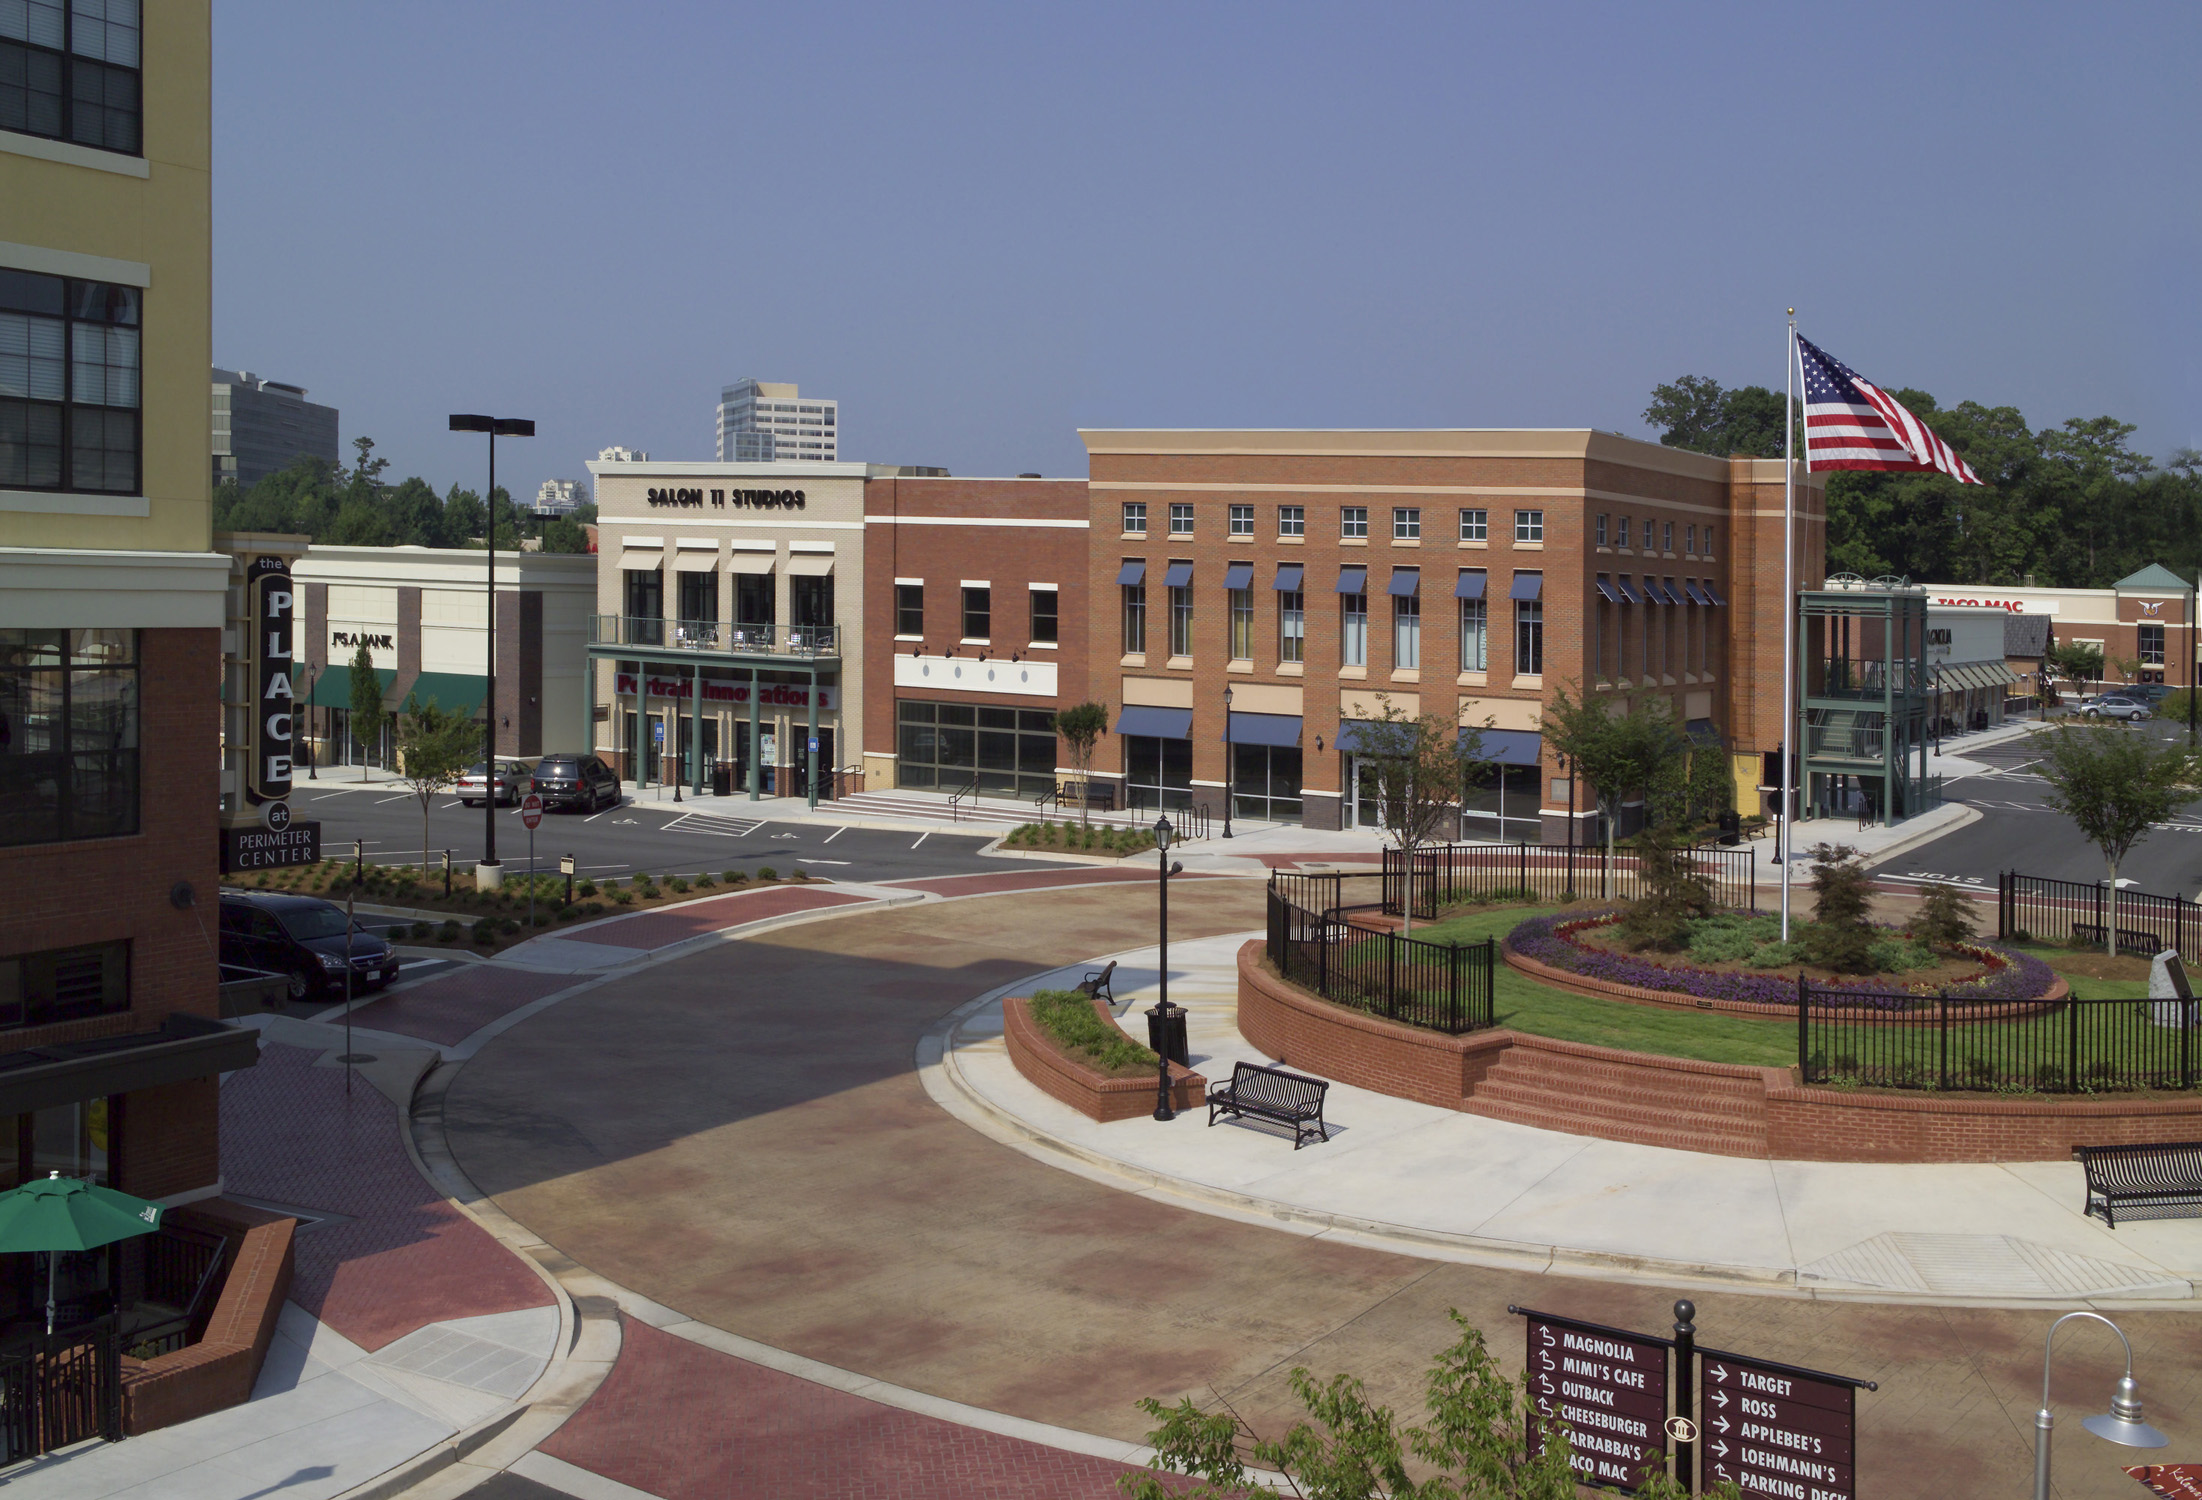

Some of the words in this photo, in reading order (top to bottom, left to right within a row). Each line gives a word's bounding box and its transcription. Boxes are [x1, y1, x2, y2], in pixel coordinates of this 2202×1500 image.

[647, 487, 703, 507] SALON
[732, 489, 806, 508] STUDIOS
[259, 558, 283, 570] the
[1984, 600, 2024, 613] MAC
[264, 590, 294, 782] PLACE
[272, 804, 287, 822] at
[239, 830, 311, 849] PERIMETER
[239, 847, 311, 867] CENTER
[1907, 872, 1985, 884] STOP
[1563, 1333, 1635, 1362] MAGNOLIA
[1563, 1357, 1610, 1381] MIMI'S
[1614, 1368, 1645, 1389] CAFE
[1740, 1371, 1792, 1397] TARGET
[1562, 1380, 1614, 1407] OUTBACK
[1561, 1404, 1648, 1438] CHEESEBURGER
[1741, 1397, 1777, 1419] ROSS
[1562, 1429, 1641, 1461] CARRABBA'S
[1740, 1422, 1822, 1454] APPLEBEE'S
[1569, 1453, 1594, 1473] ACO
[1598, 1461, 1628, 1482] MAC
[1741, 1447, 1836, 1483] LOEHMANN'S
[1740, 1471, 1805, 1500] PARKING
